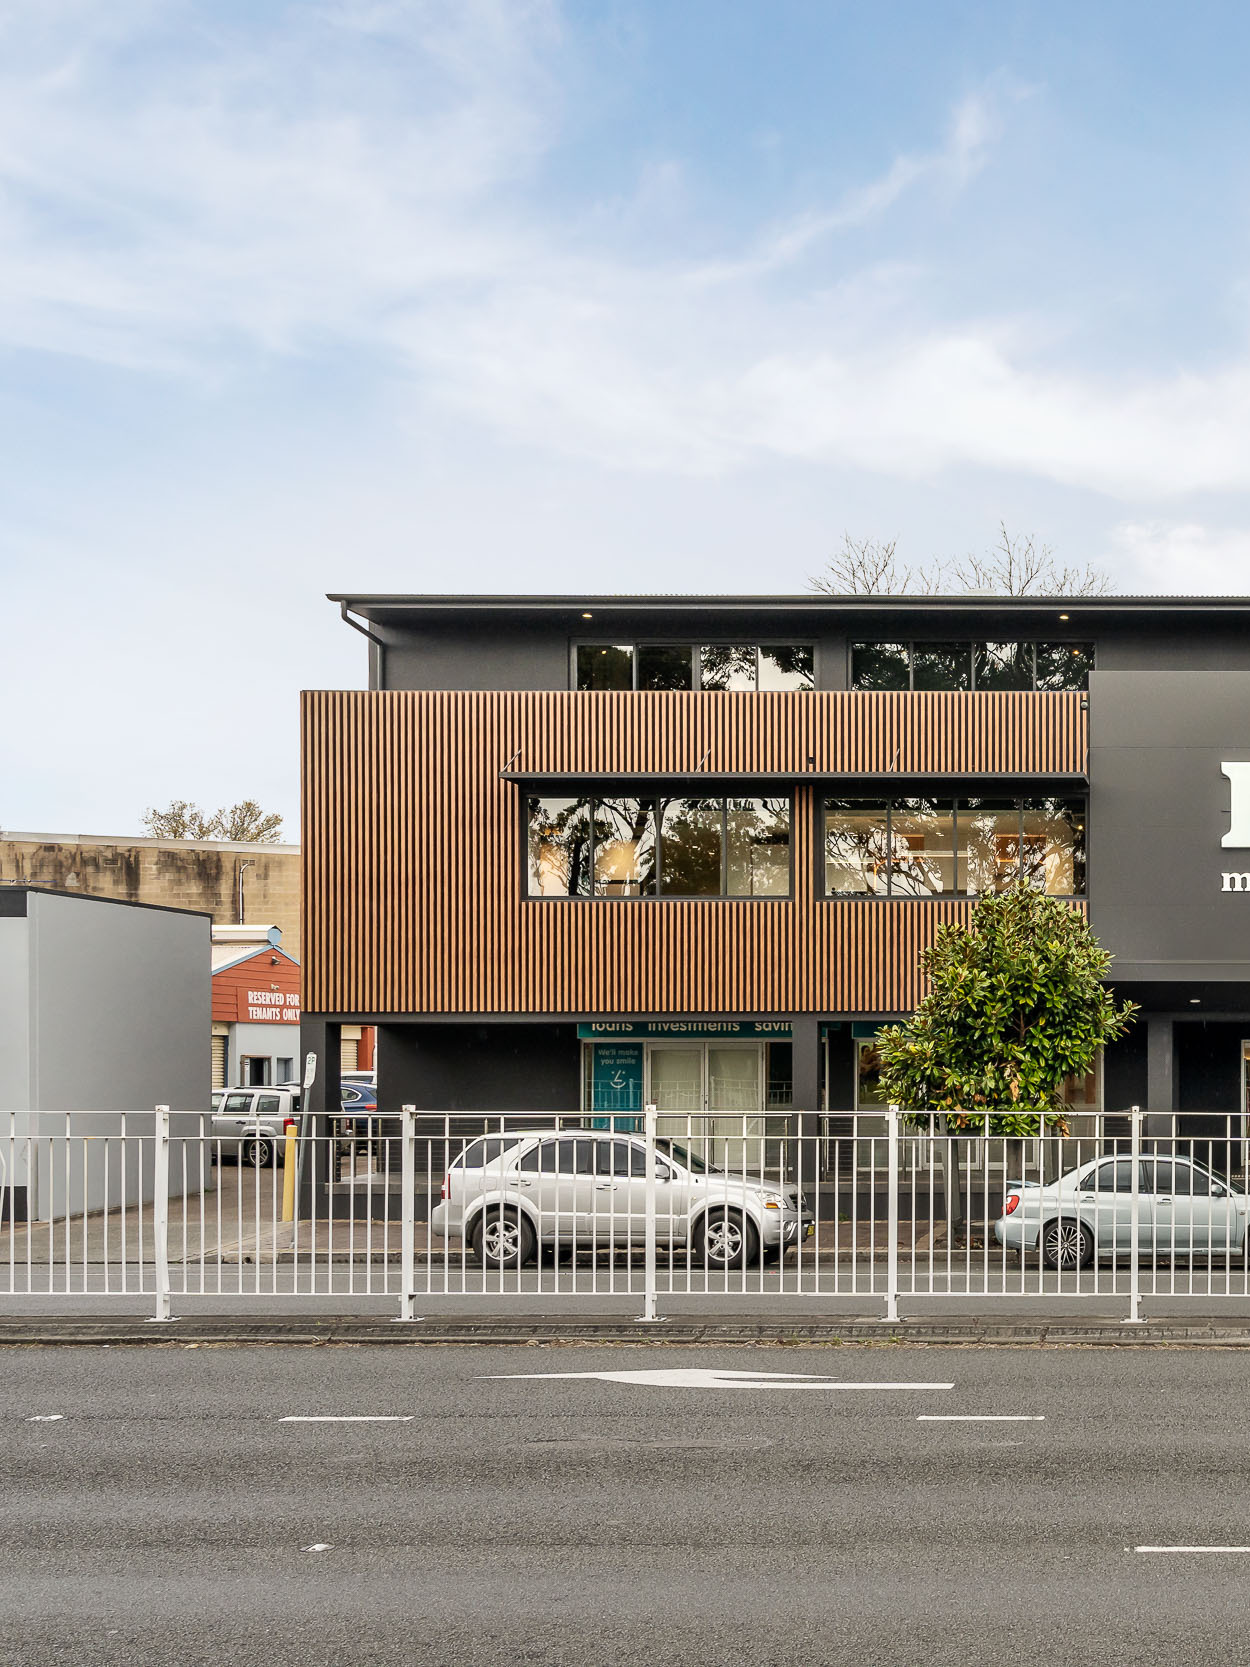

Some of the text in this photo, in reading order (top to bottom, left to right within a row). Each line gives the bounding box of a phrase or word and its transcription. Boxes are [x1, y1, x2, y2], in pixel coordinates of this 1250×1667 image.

[248, 991, 300, 1006] RESERVED FOR
[248, 1006, 300, 1021] TENANTS ONLY
[598, 1048, 616, 1056] We'll
[307, 1056, 315, 1064] 2P
[601, 1058, 614, 1066] you
